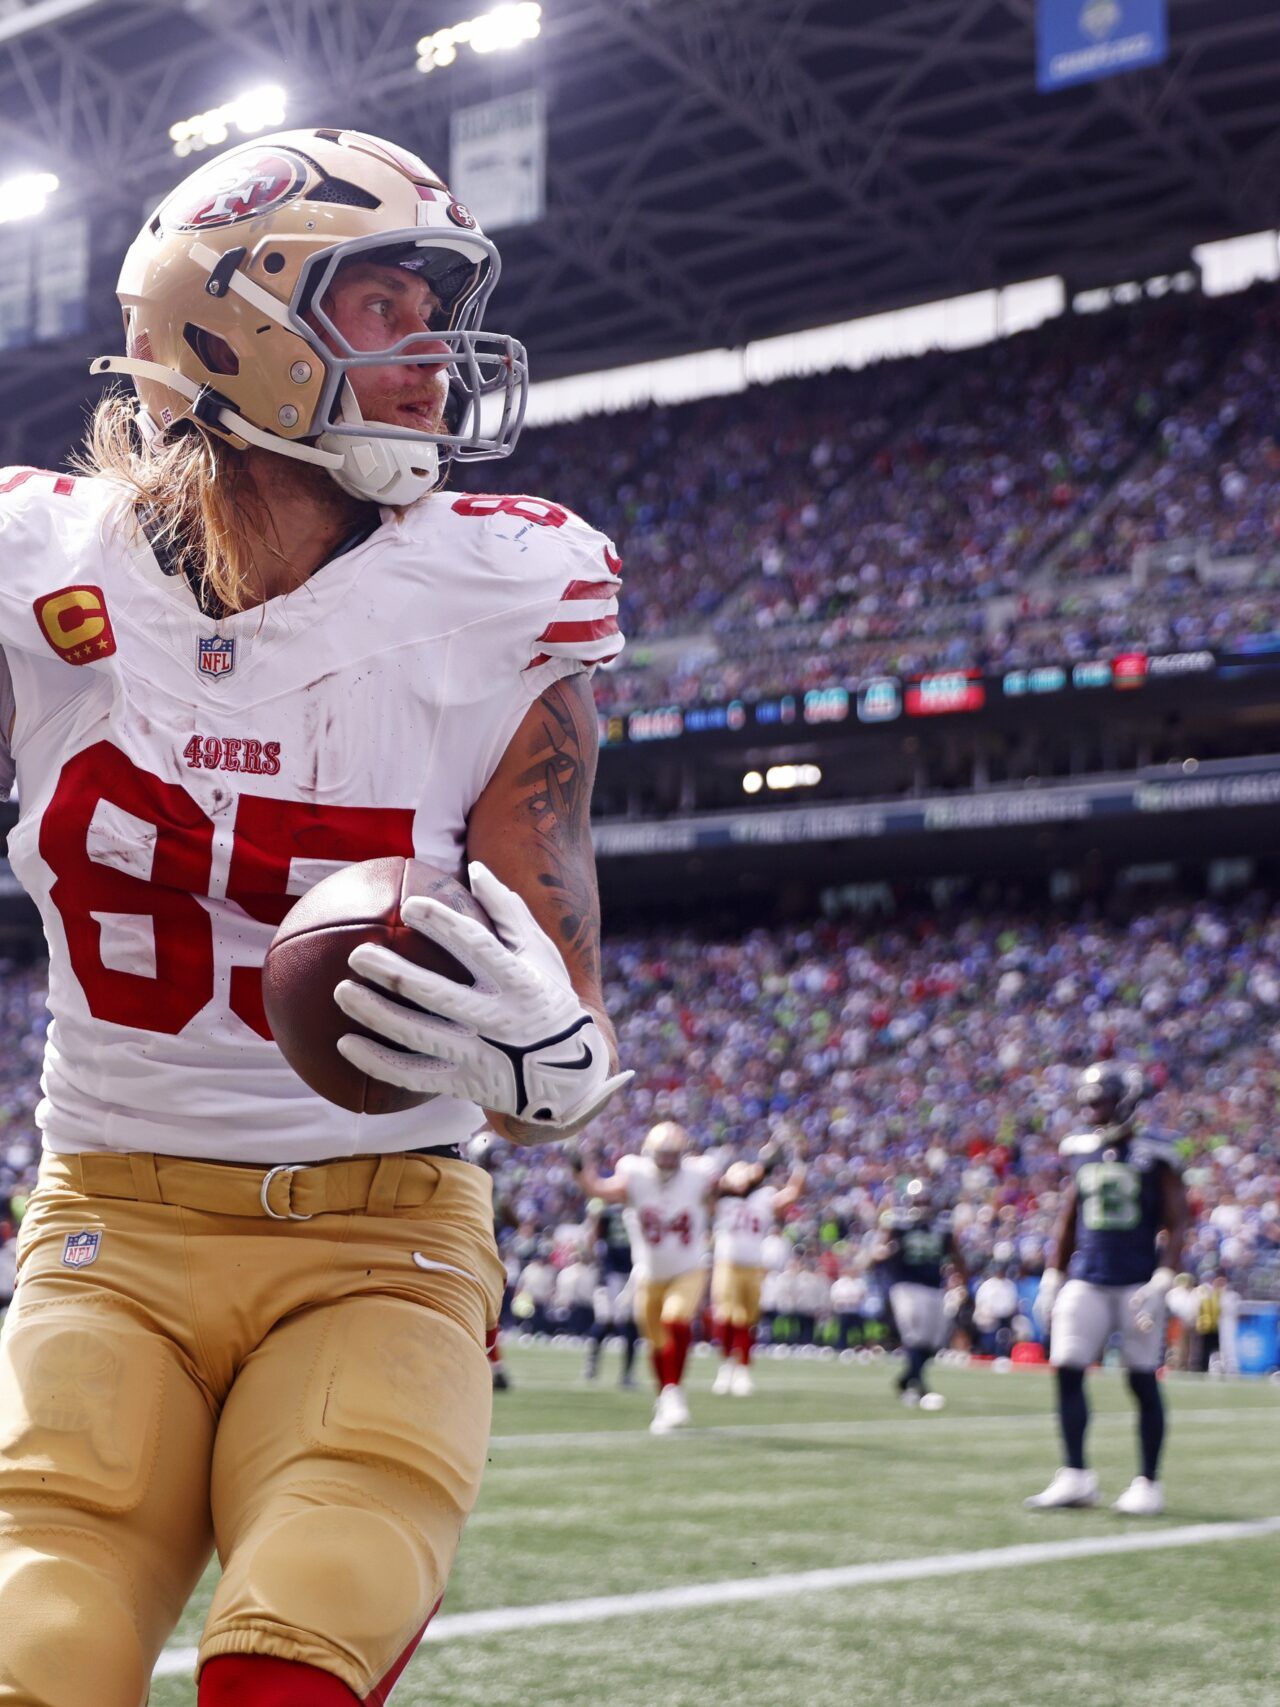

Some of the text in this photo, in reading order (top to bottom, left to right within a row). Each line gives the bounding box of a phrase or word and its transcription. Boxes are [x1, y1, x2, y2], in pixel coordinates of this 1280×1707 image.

[41, 590, 105, 649] C
[202, 652, 230, 673] NFL
[183, 734, 281, 776] 49ERS
[38, 739, 416, 1041] 85
[66, 1246, 91, 1265] NFL
